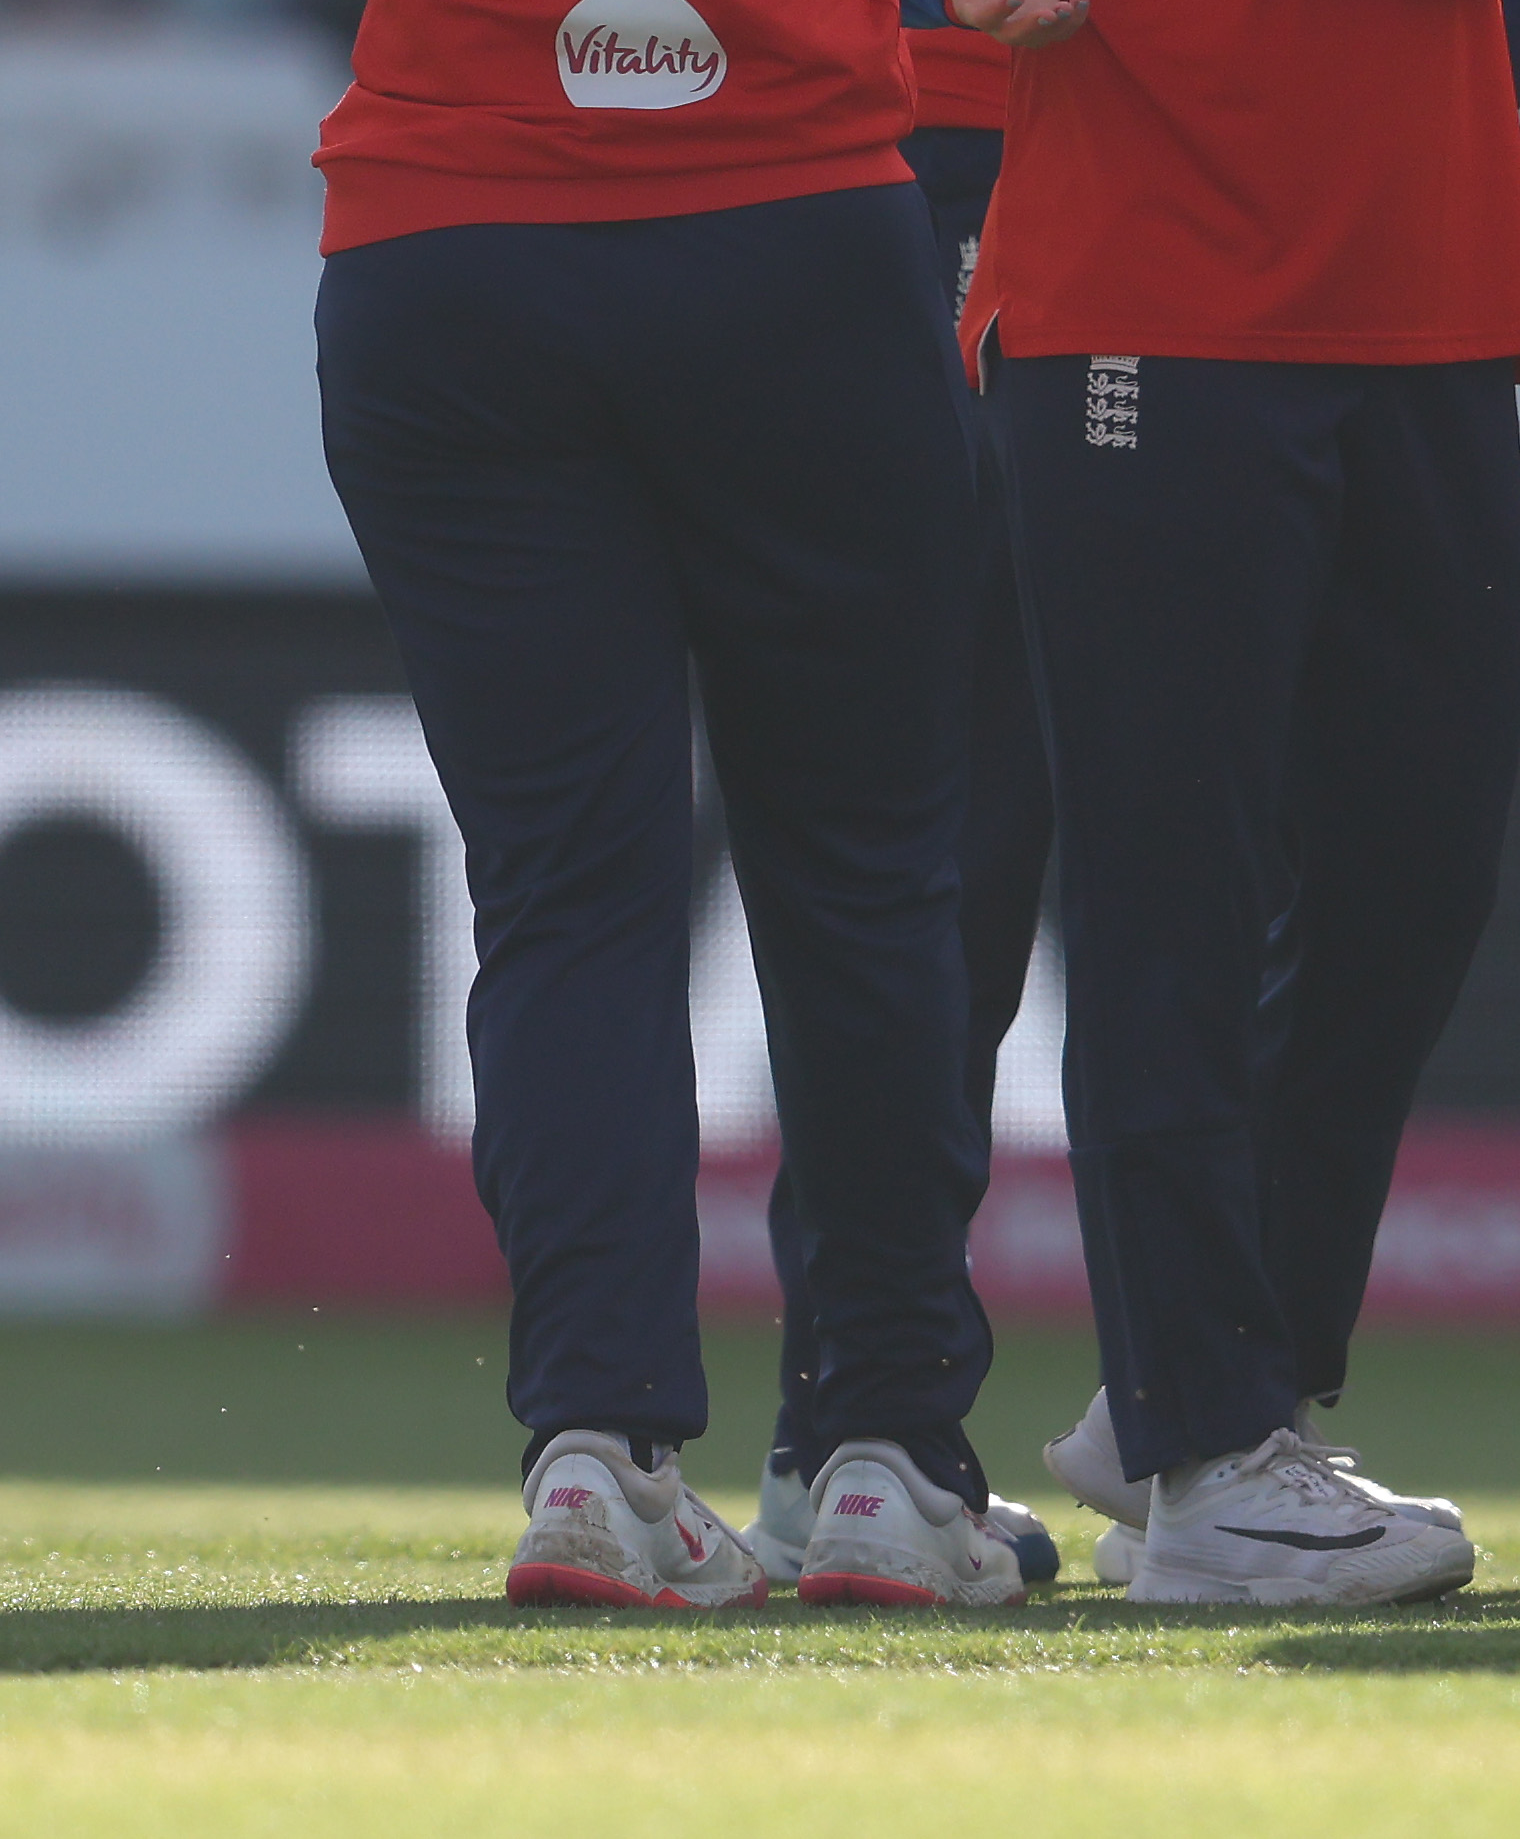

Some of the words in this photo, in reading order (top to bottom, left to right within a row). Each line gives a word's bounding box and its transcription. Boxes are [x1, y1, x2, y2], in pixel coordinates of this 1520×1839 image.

[563, 24, 719, 93] Vitality
[543, 1487, 593, 1509] NIKE
[833, 1493, 885, 1518] NIKE
